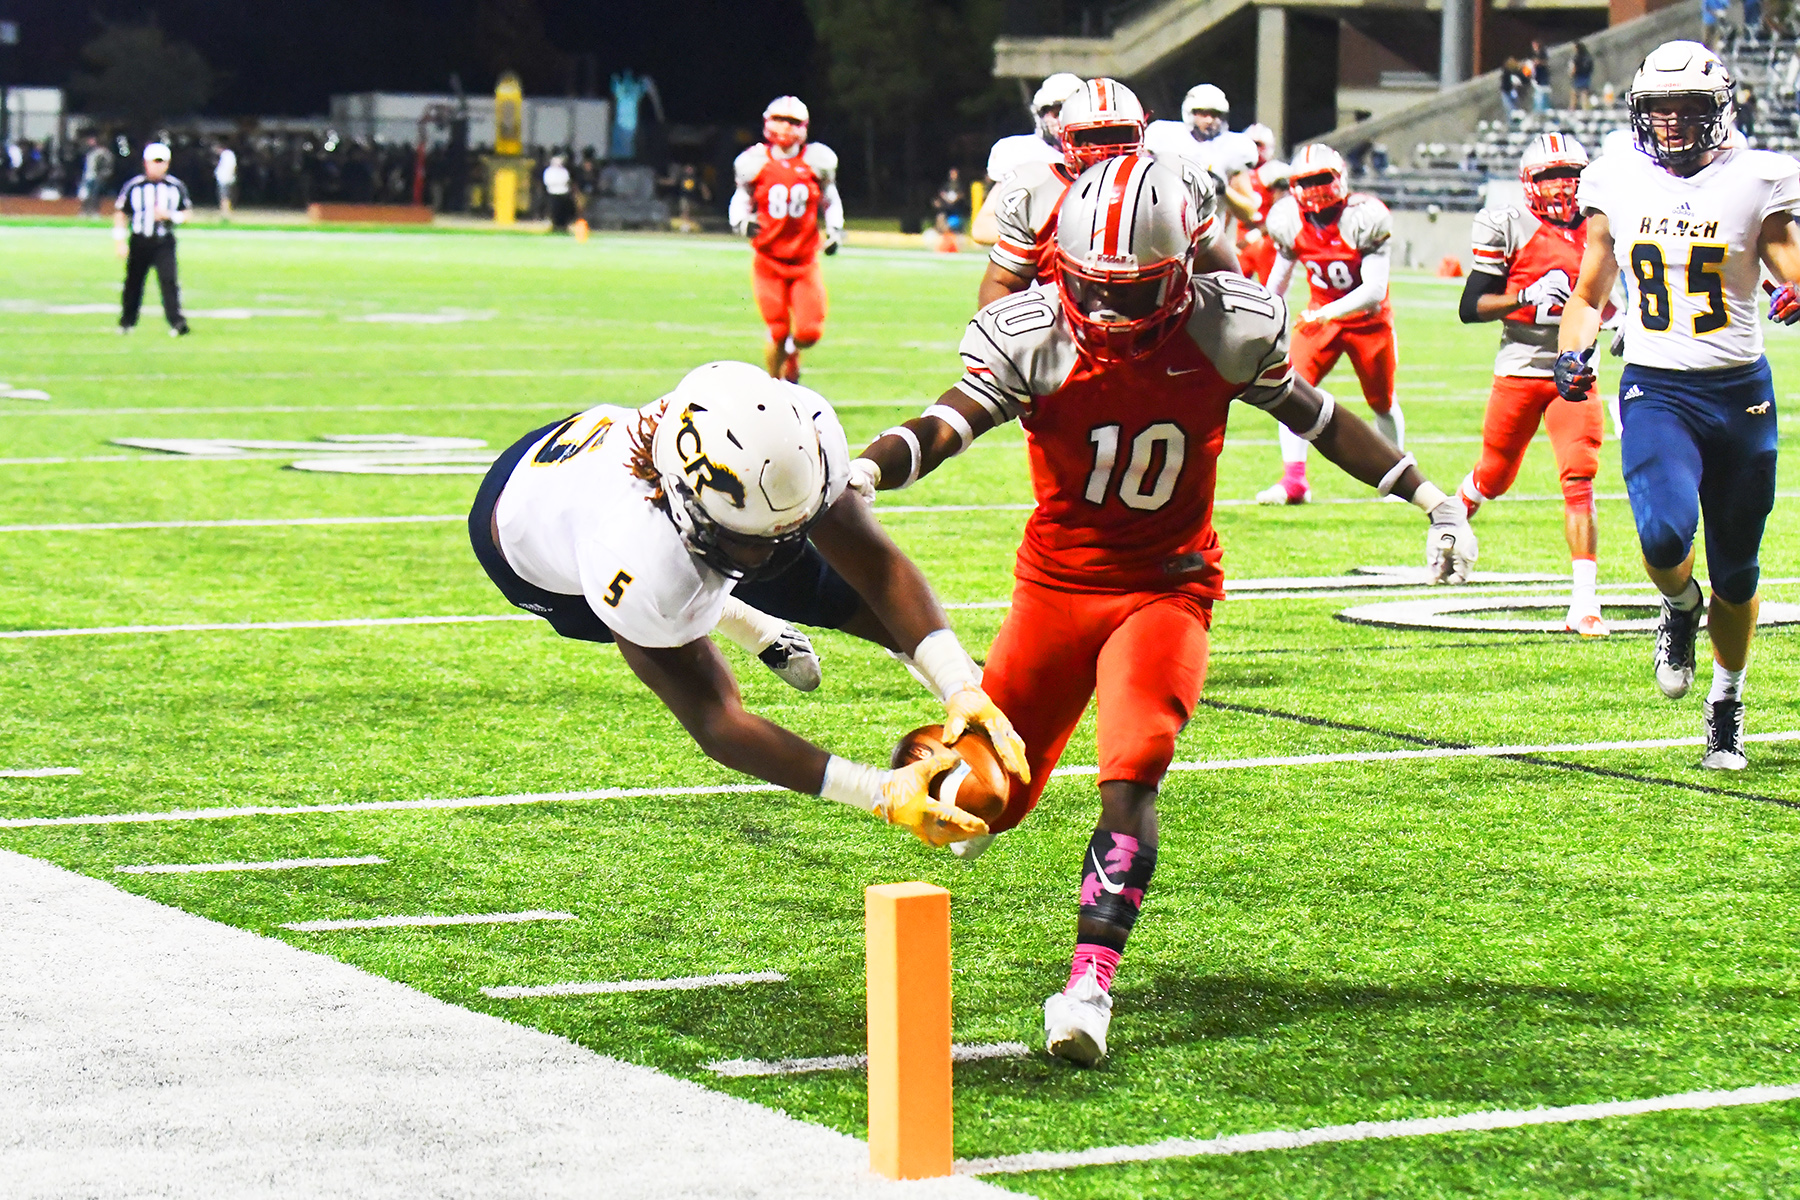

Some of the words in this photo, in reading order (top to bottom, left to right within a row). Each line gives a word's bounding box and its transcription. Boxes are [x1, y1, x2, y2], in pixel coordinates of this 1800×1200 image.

[768, 183, 809, 219] 88
[1213, 273, 1273, 320] 10
[1629, 240, 1729, 338] 85
[987, 290, 1056, 337] 10
[1084, 422, 1186, 512] 10
[603, 568, 635, 609] 5
